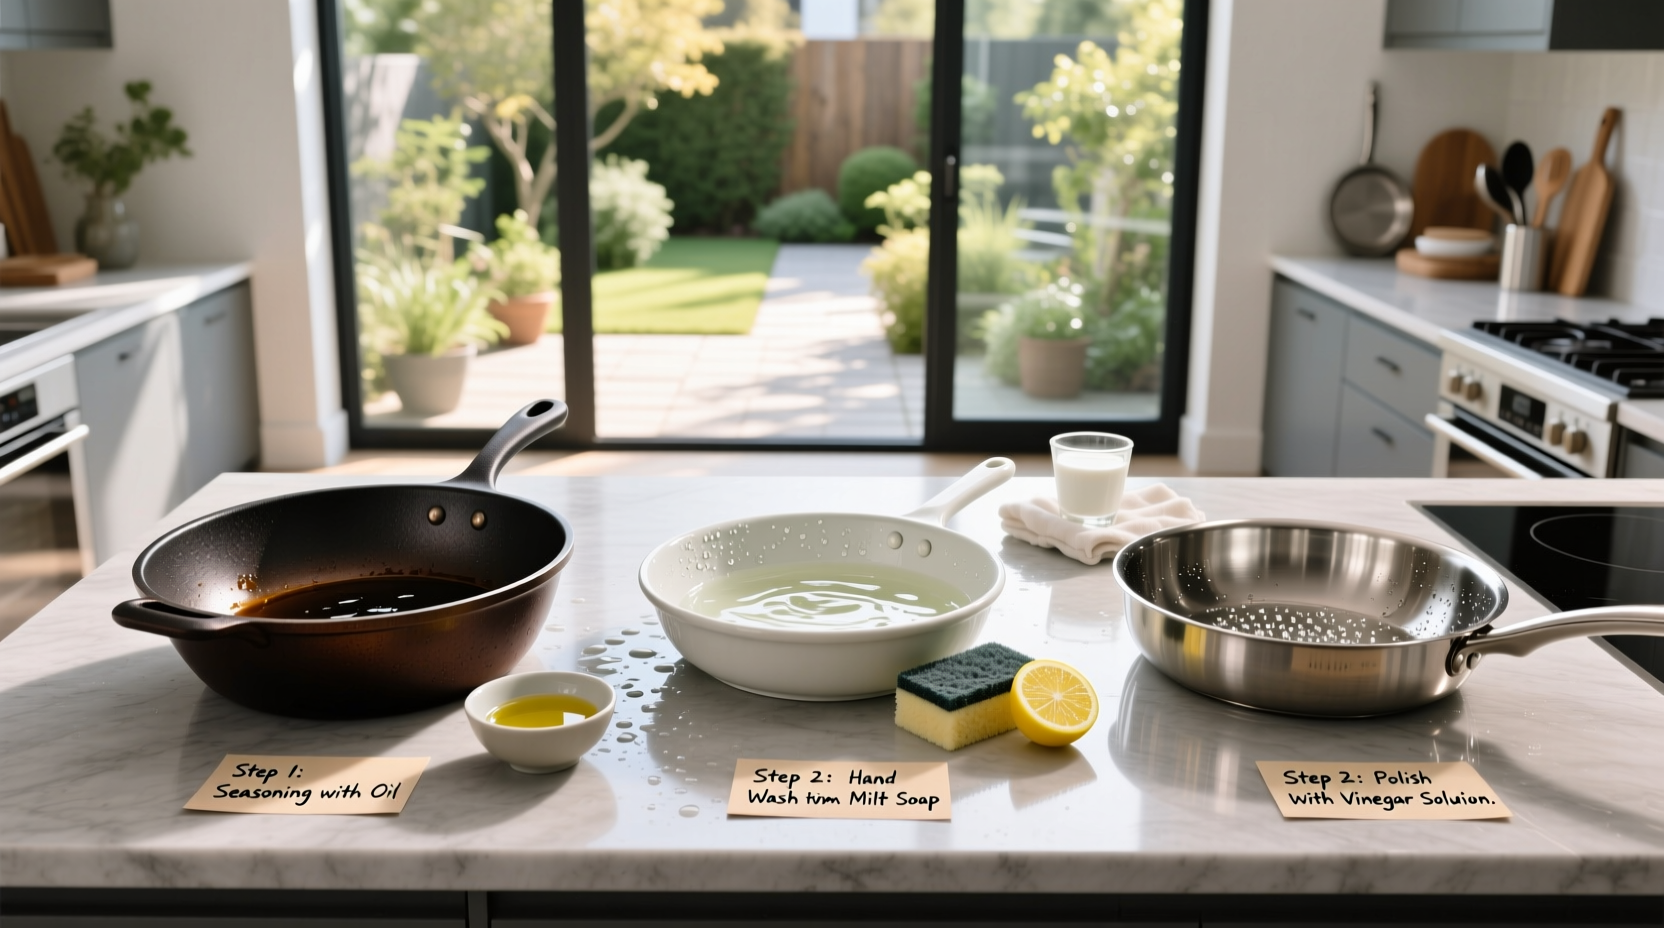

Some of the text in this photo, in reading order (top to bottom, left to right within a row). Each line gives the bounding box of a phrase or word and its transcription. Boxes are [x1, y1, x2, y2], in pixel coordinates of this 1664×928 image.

[231, 763, 303, 784] Step 1:
[753, 769, 896, 788] Step 2: Hand
[1283, 770, 1432, 790] Step 2: Polish
[213, 782, 401, 806] Seasoning with Oil
[749, 789, 799, 804] Wash
[849, 791, 888, 806] Milt
[896, 792, 940, 811] Soap
[1340, 791, 1413, 811] Vinegar
[1420, 790, 1496, 805] Soluion.
